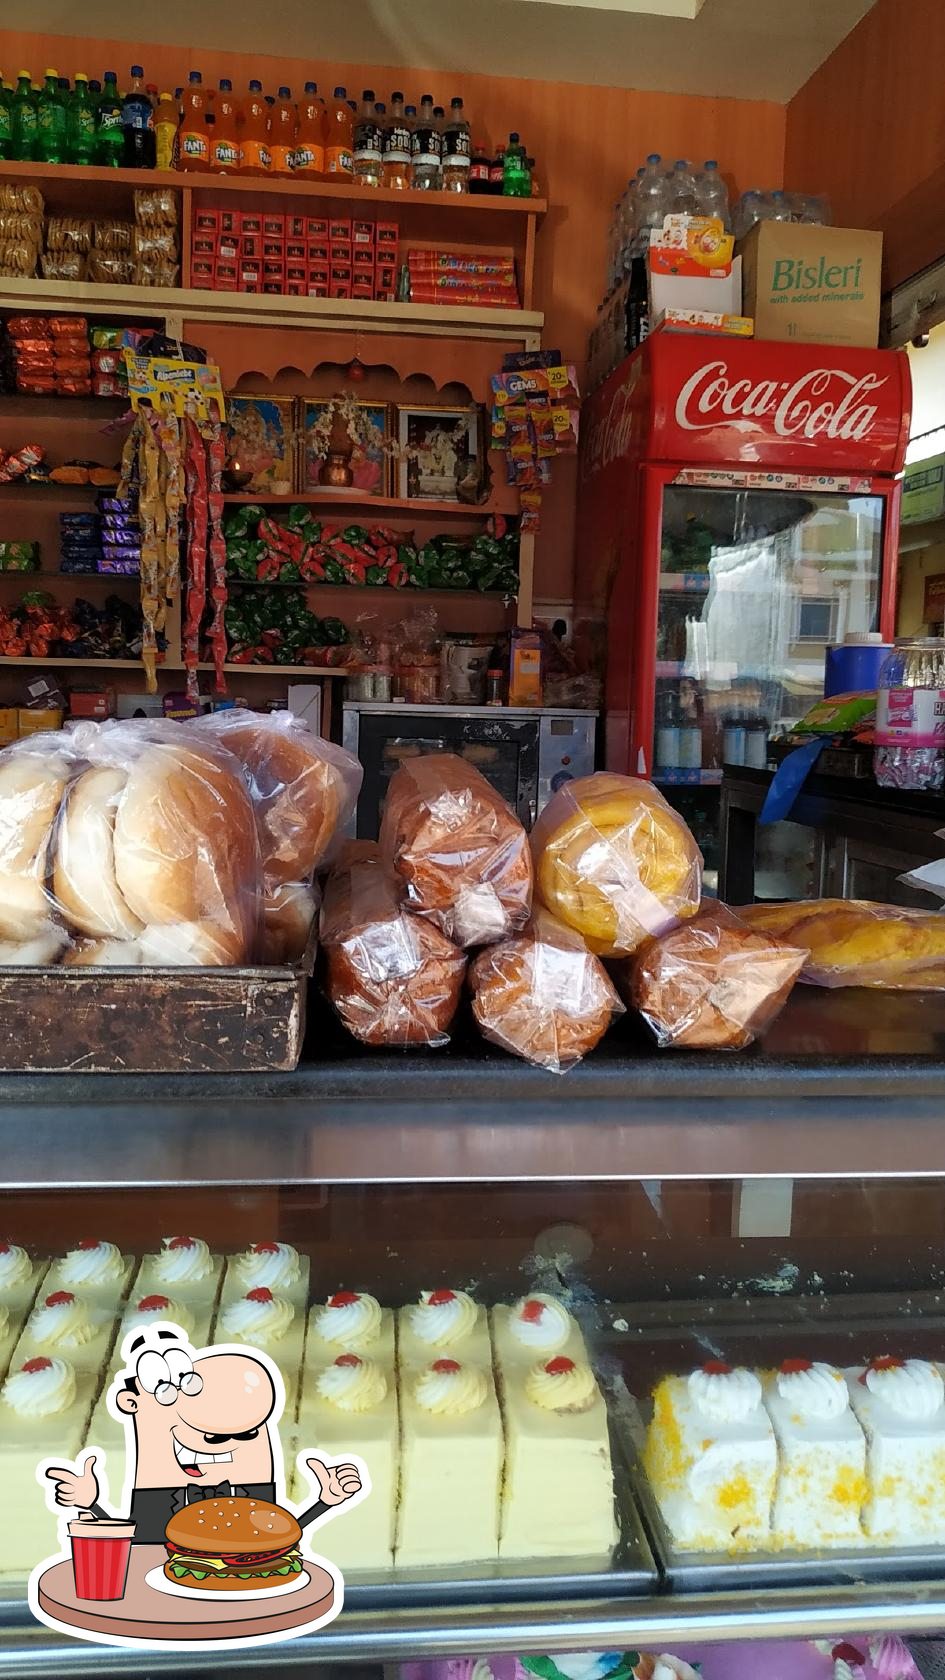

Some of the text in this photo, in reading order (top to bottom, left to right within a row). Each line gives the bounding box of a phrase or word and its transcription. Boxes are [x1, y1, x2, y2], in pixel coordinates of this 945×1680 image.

[771, 256, 863, 291] Bisleri
[769, 292, 864, 304] with added minerals
[509, 378, 537, 391] GEMS
